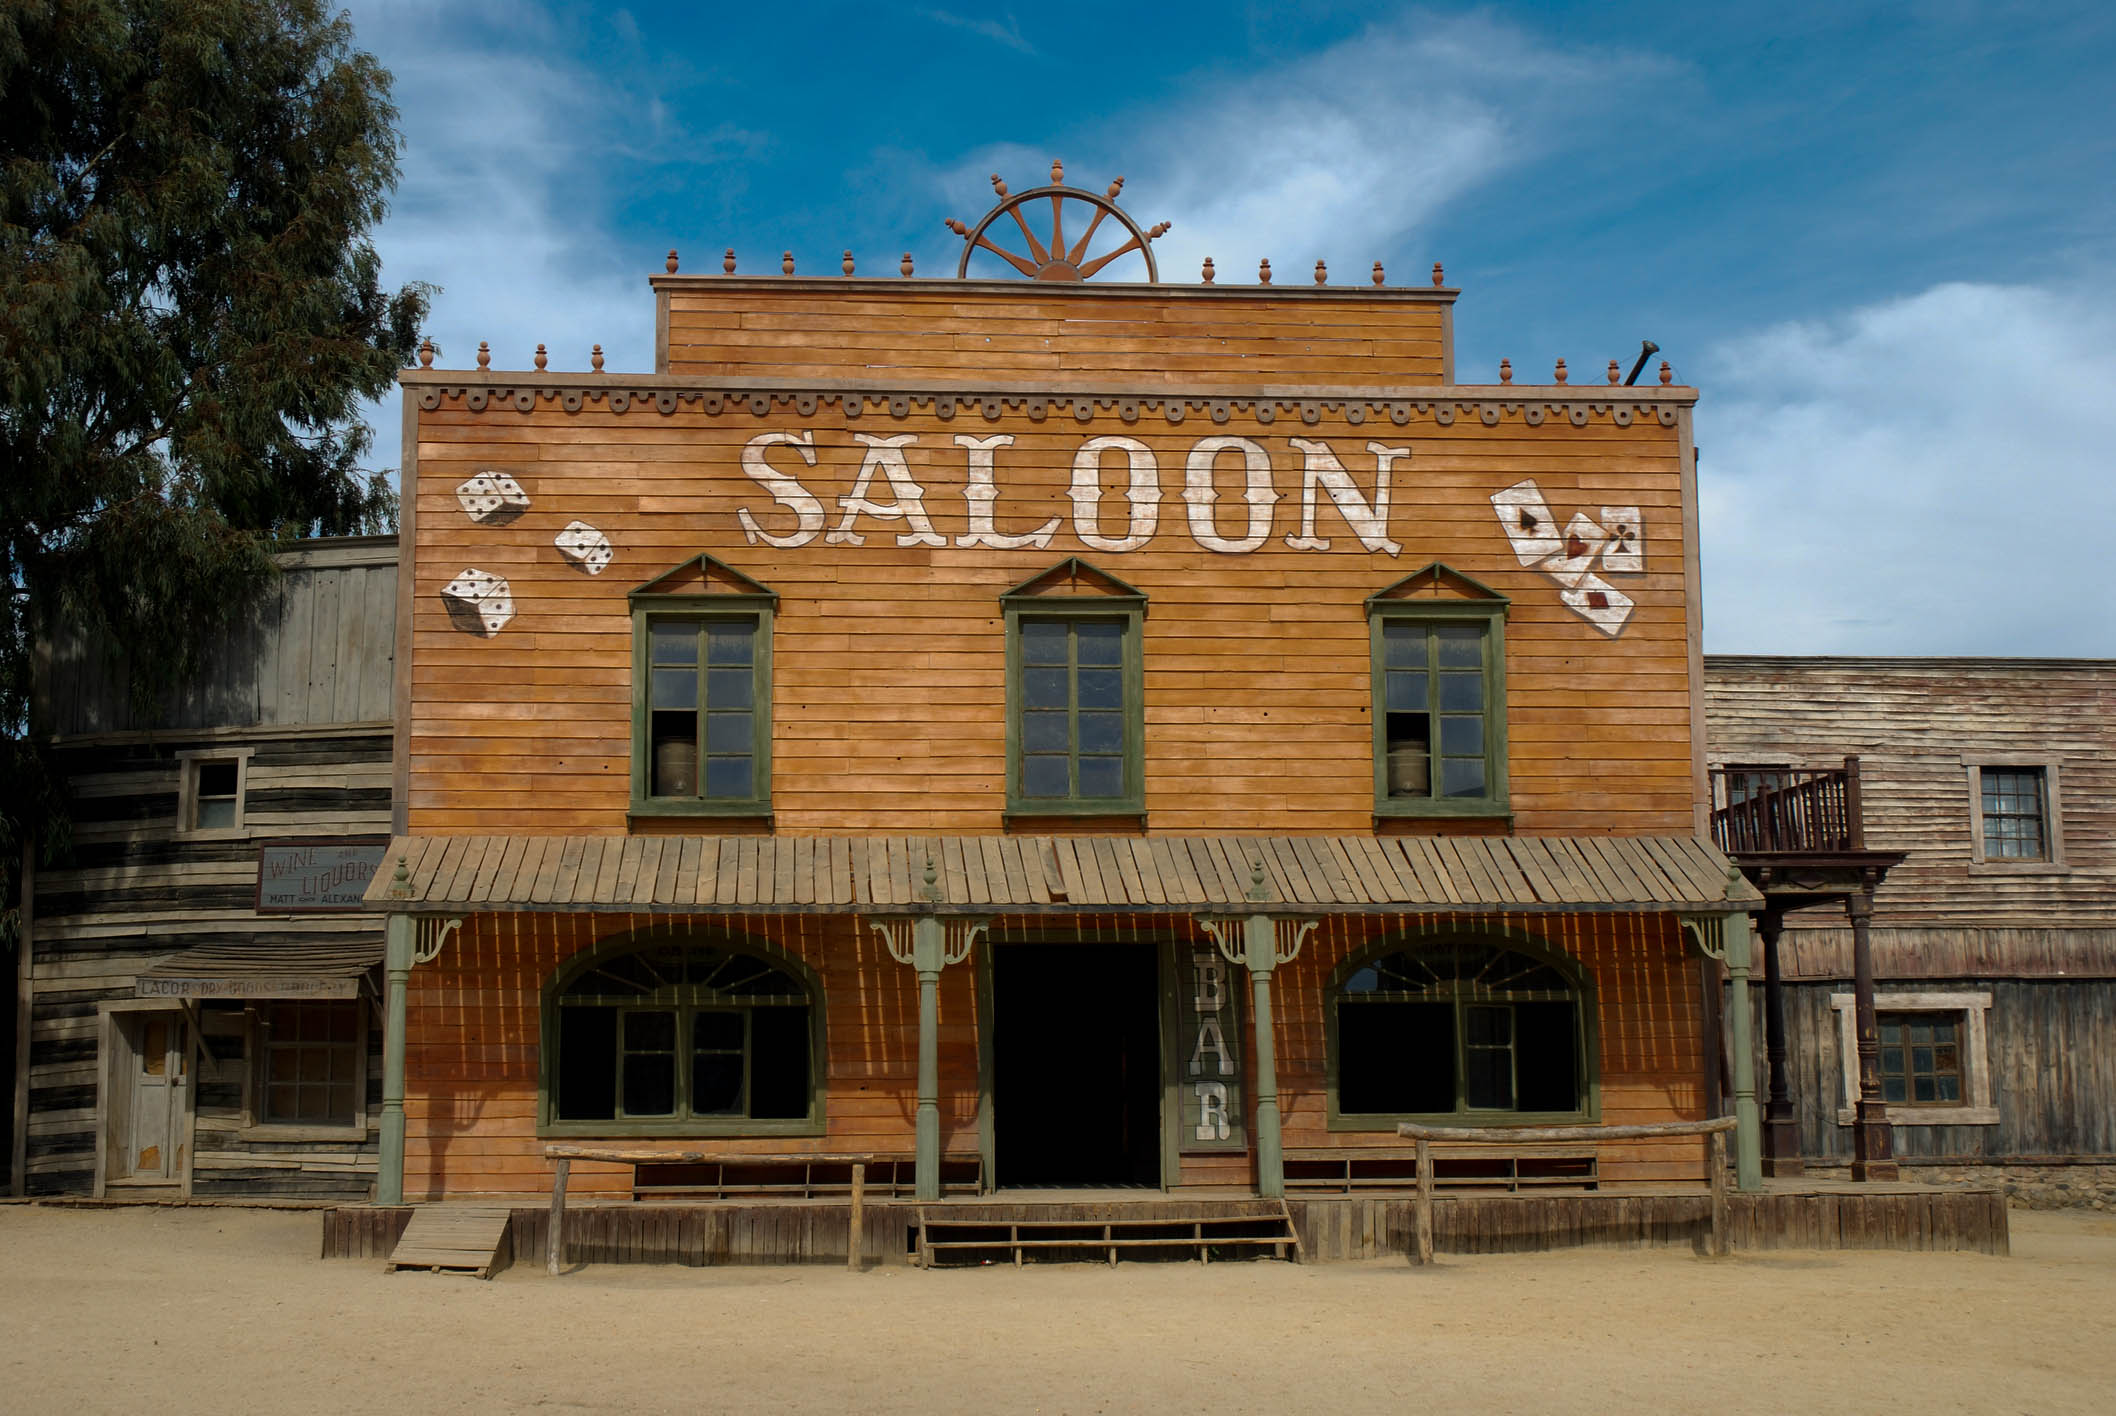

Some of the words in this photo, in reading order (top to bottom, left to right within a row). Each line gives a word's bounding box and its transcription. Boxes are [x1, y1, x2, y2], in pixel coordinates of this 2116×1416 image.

[736, 430, 1410, 557] SALOON
[272, 847, 318, 881] WINE
[270, 895, 297, 904] MATT
[141, 980, 190, 996] LACOR
[1190, 953, 1235, 1141] BAR
